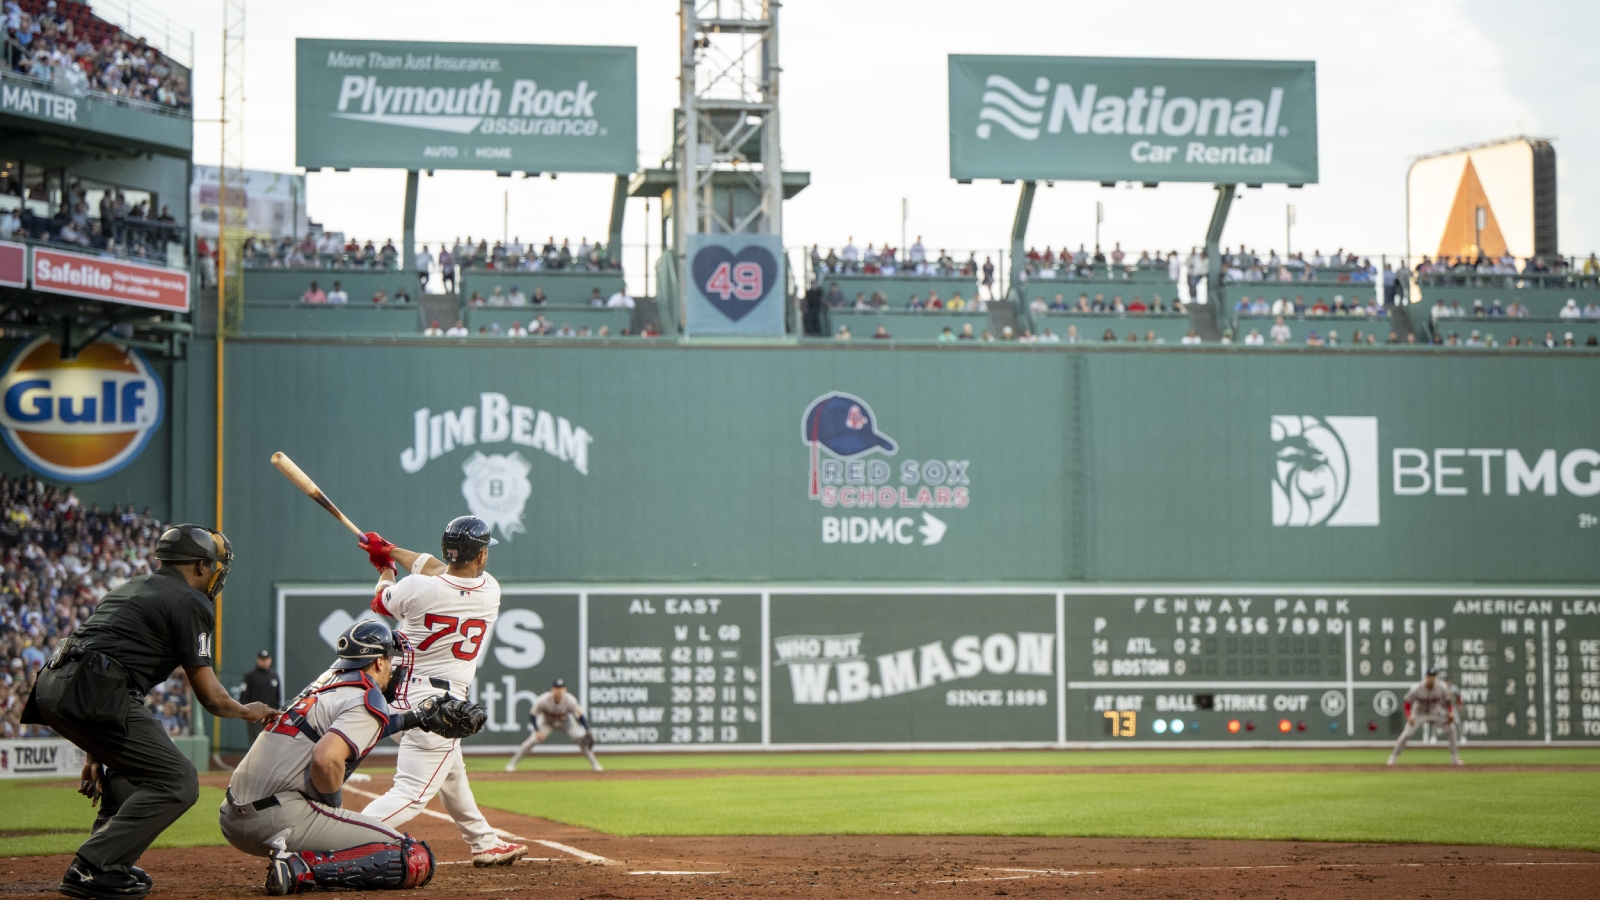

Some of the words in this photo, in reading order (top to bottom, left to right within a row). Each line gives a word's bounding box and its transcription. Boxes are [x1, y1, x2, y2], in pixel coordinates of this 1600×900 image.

[327, 51, 366, 69] More
[368, 52, 401, 69] Than
[404, 53, 432, 71] Just
[2, 85, 77, 122] MATTER
[337, 75, 502, 117] Plymouth
[508, 79, 598, 117] Rock
[1046, 83, 1284, 137] National
[480, 116, 599, 136] assurance
[423, 146, 458, 158] AUTO
[475, 147, 512, 159] HOME
[1131, 141, 1178, 163] Car
[1186, 142, 1273, 165] Rental
[37, 259, 112, 291] Safelite
[705, 262, 763, 300] 49
[4, 380, 146, 423] Gulf
[401, 406, 477, 474] JIM
[480, 391, 594, 476] BEAM
[821, 459, 891, 485] RED
[900, 459, 970, 485] SOX
[1393, 448, 1600, 497] BETMG
[821, 485, 970, 508] SCHOLARS
[822, 516, 914, 544] BIDMC
[629, 599, 656, 614] AL
[665, 599, 722, 614] EAST
[1134, 598, 1252, 614] FENWAY
[1274, 598, 1350, 614] PARK
[1453, 599, 1553, 615] AMERICAN
[1562, 600, 1600, 615] LEA
[674, 625, 688, 641] W
[699, 625, 711, 641] L
[1094, 617, 1107, 634] P
[1189, 616, 1201, 633] 2
[1205, 616, 1217, 634] 3
[1225, 616, 1238, 634] 4
[1241, 617, 1253, 634] 5
[1255, 617, 1269, 634] 6
[1277, 617, 1288, 634] 7
[1292, 617, 1305, 634] 8
[1306, 617, 1320, 634] 9
[1326, 617, 1344, 634] 10
[1358, 617, 1371, 634] R
[1381, 617, 1394, 634] H
[1404, 617, 1415, 634] E
[1433, 618, 1446, 634] P
[1523, 618, 1536, 634] R
[1554, 618, 1567, 634] P
[417, 613, 488, 662] 73
[1126, 637, 1157, 655] ATL
[1174, 638, 1186, 654] 0
[1190, 638, 1201, 654] 2
[1360, 638, 1370, 655] 2
[1404, 638, 1415, 654] 0
[1463, 638, 1485, 654] KC
[589, 646, 621, 663] NEW
[624, 646, 663, 663] YORK
[671, 646, 692, 663] 42
[696, 646, 714, 663] 19
[775, 639, 820, 658] WHO
[823, 638, 861, 658] BUT
[1112, 659, 1169, 676] BOSTON
[1174, 659, 1186, 676] 0
[1359, 659, 1371, 676] 0
[1382, 659, 1394, 676] 0
[1405, 659, 1416, 676] 2
[1459, 655, 1490, 671] CLE
[589, 667, 666, 683] BALTIMORE
[723, 666, 735, 683] 2
[589, 686, 648, 703] BOSTON
[946, 689, 1003, 706] SINCE
[1094, 695, 1114, 711] AT
[1116, 695, 1144, 711] BAT
[1155, 695, 1197, 711] BALL
[1213, 695, 1268, 711] STRIKE
[1273, 694, 1309, 712] OUT
[590, 707, 635, 723] TAMPA
[637, 707, 665, 723] BAY
[1104, 710, 1136, 737] 73
[590, 726, 659, 743] TORONTO
[14, 746, 58, 764] TRULY
